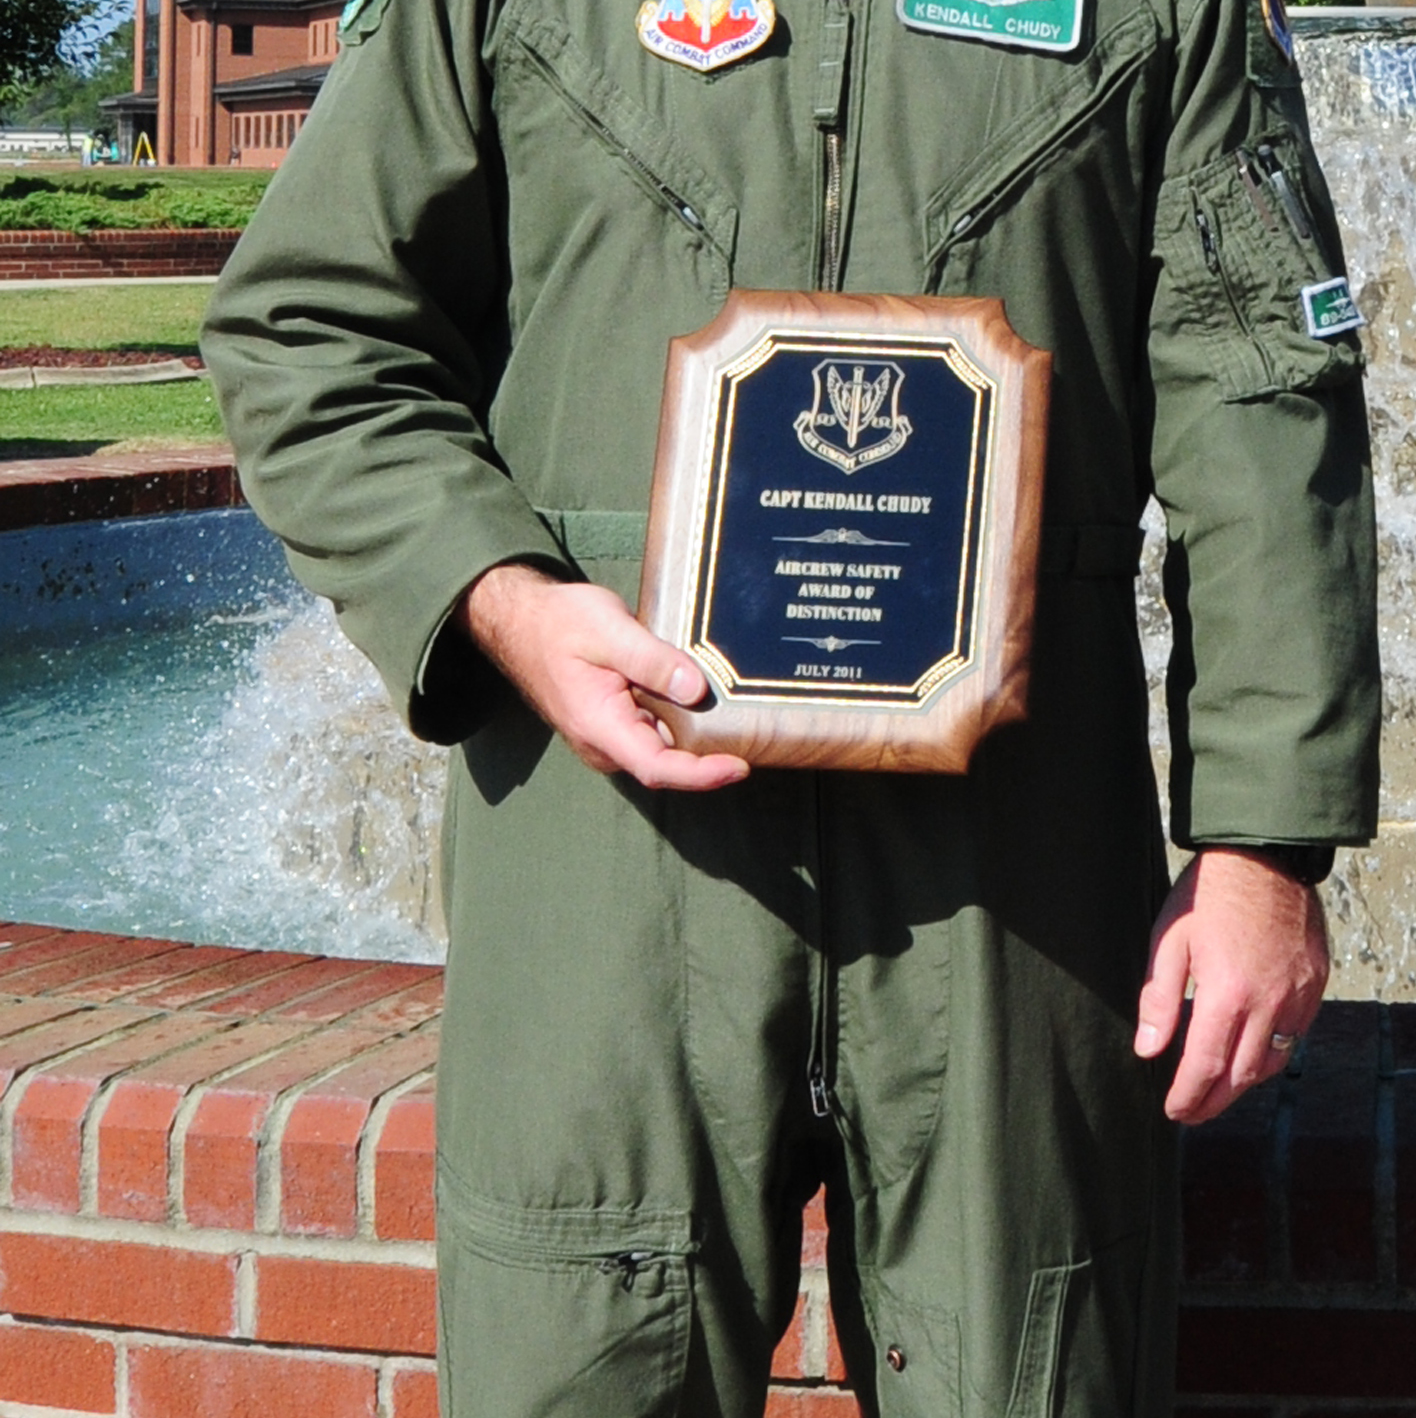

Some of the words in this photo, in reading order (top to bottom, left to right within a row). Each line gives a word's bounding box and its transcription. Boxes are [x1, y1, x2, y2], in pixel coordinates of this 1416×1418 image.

[914, 2, 993, 29] KENDALL
[1005, 18, 1061, 39] CHUDY
[645, 28, 664, 46] AIR
[665, 42, 712, 65] COMBAT
[714, 23, 768, 59] COMMAND
[760, 489, 803, 508] CAPT
[803, 490, 875, 512] KENDALL
[876, 494, 932, 514] CHUDY
[774, 560, 844, 577] AIRCREW
[846, 563, 901, 580] SAFETY
[797, 582, 852, 599] AWARD
[854, 585, 875, 600] OF
[785, 603, 882, 622] DISTINCTION
[794, 663, 831, 677] JULY
[832, 665, 863, 679] 2011
